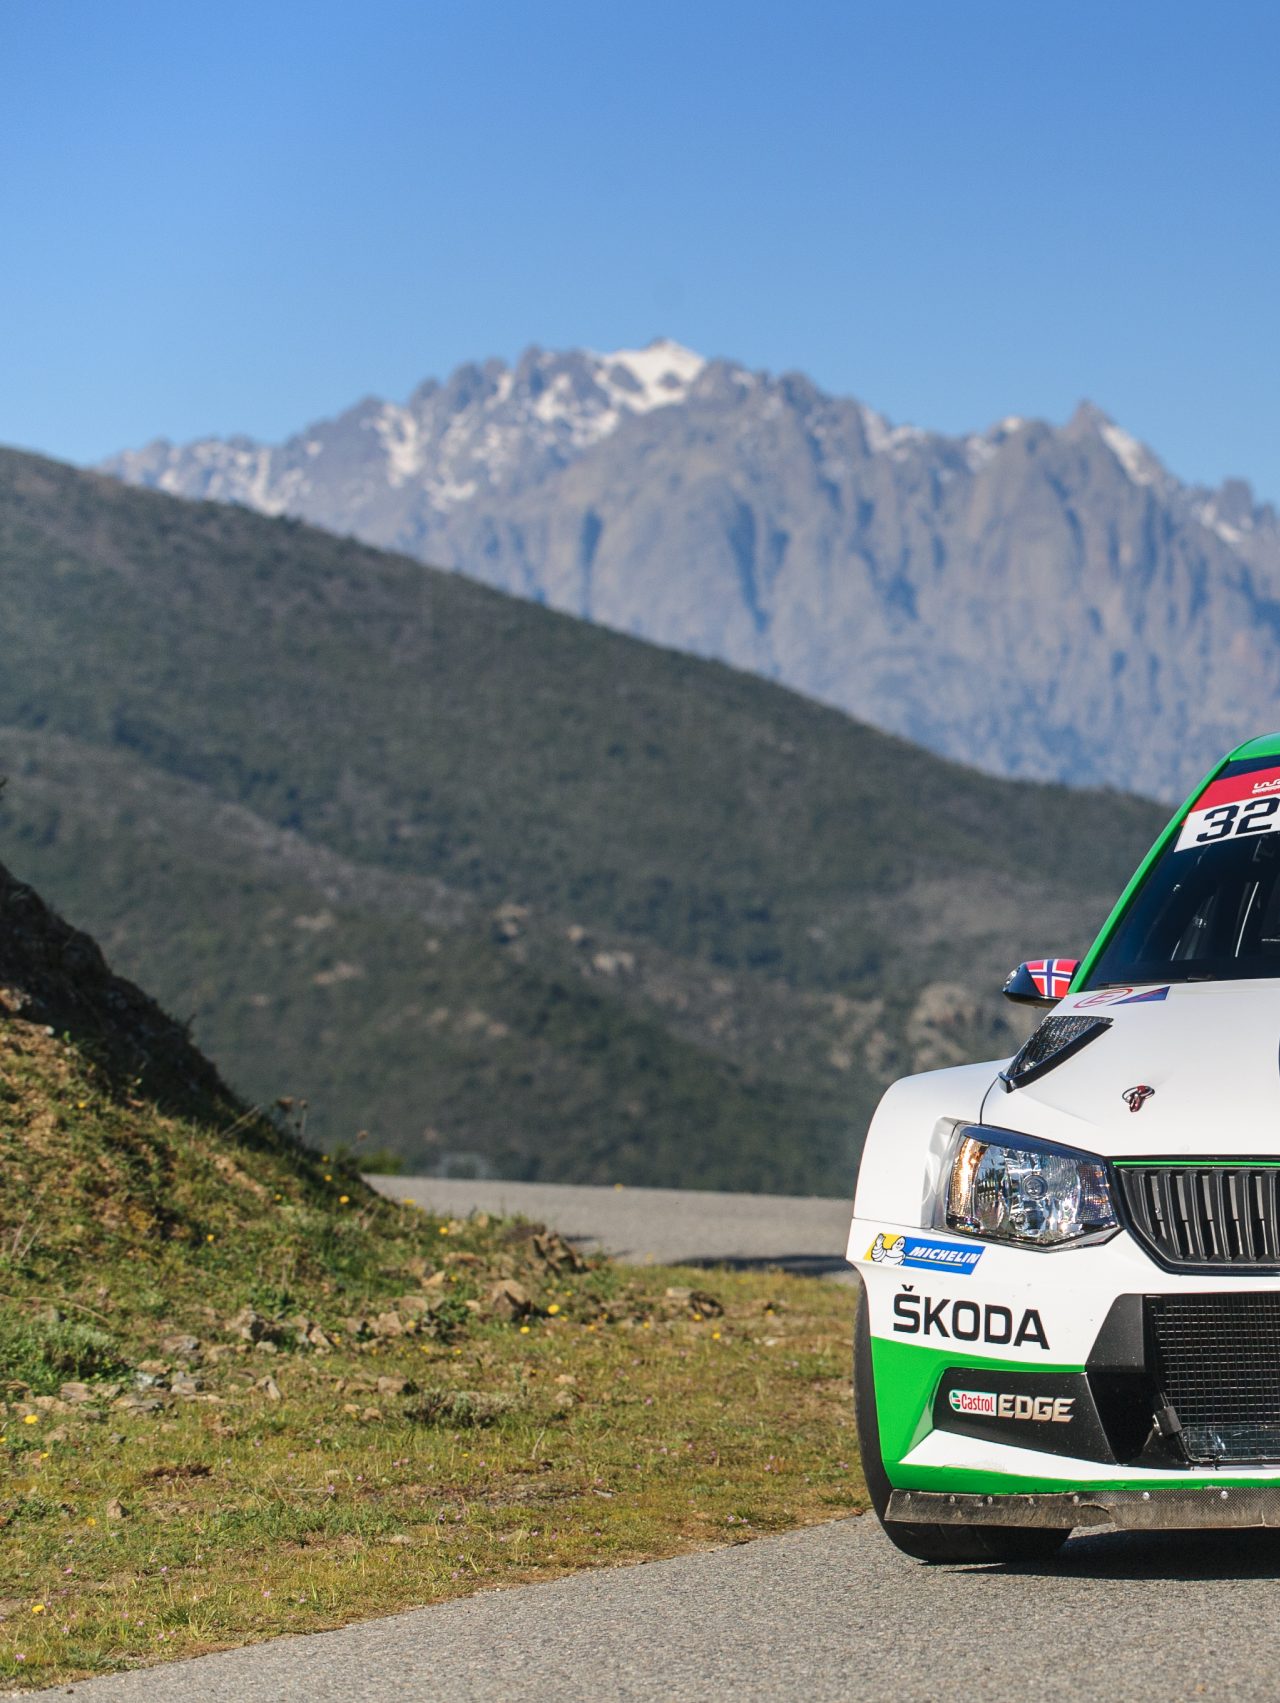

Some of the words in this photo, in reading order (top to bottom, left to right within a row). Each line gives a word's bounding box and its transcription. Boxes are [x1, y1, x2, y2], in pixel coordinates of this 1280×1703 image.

[1196, 797, 1280, 843] 32
[908, 1246, 981, 1264] MICHELIN
[893, 1284, 1050, 1350] ŠKODA
[960, 1393, 994, 1413] Castrol
[997, 1393, 1076, 1422] EDGE
